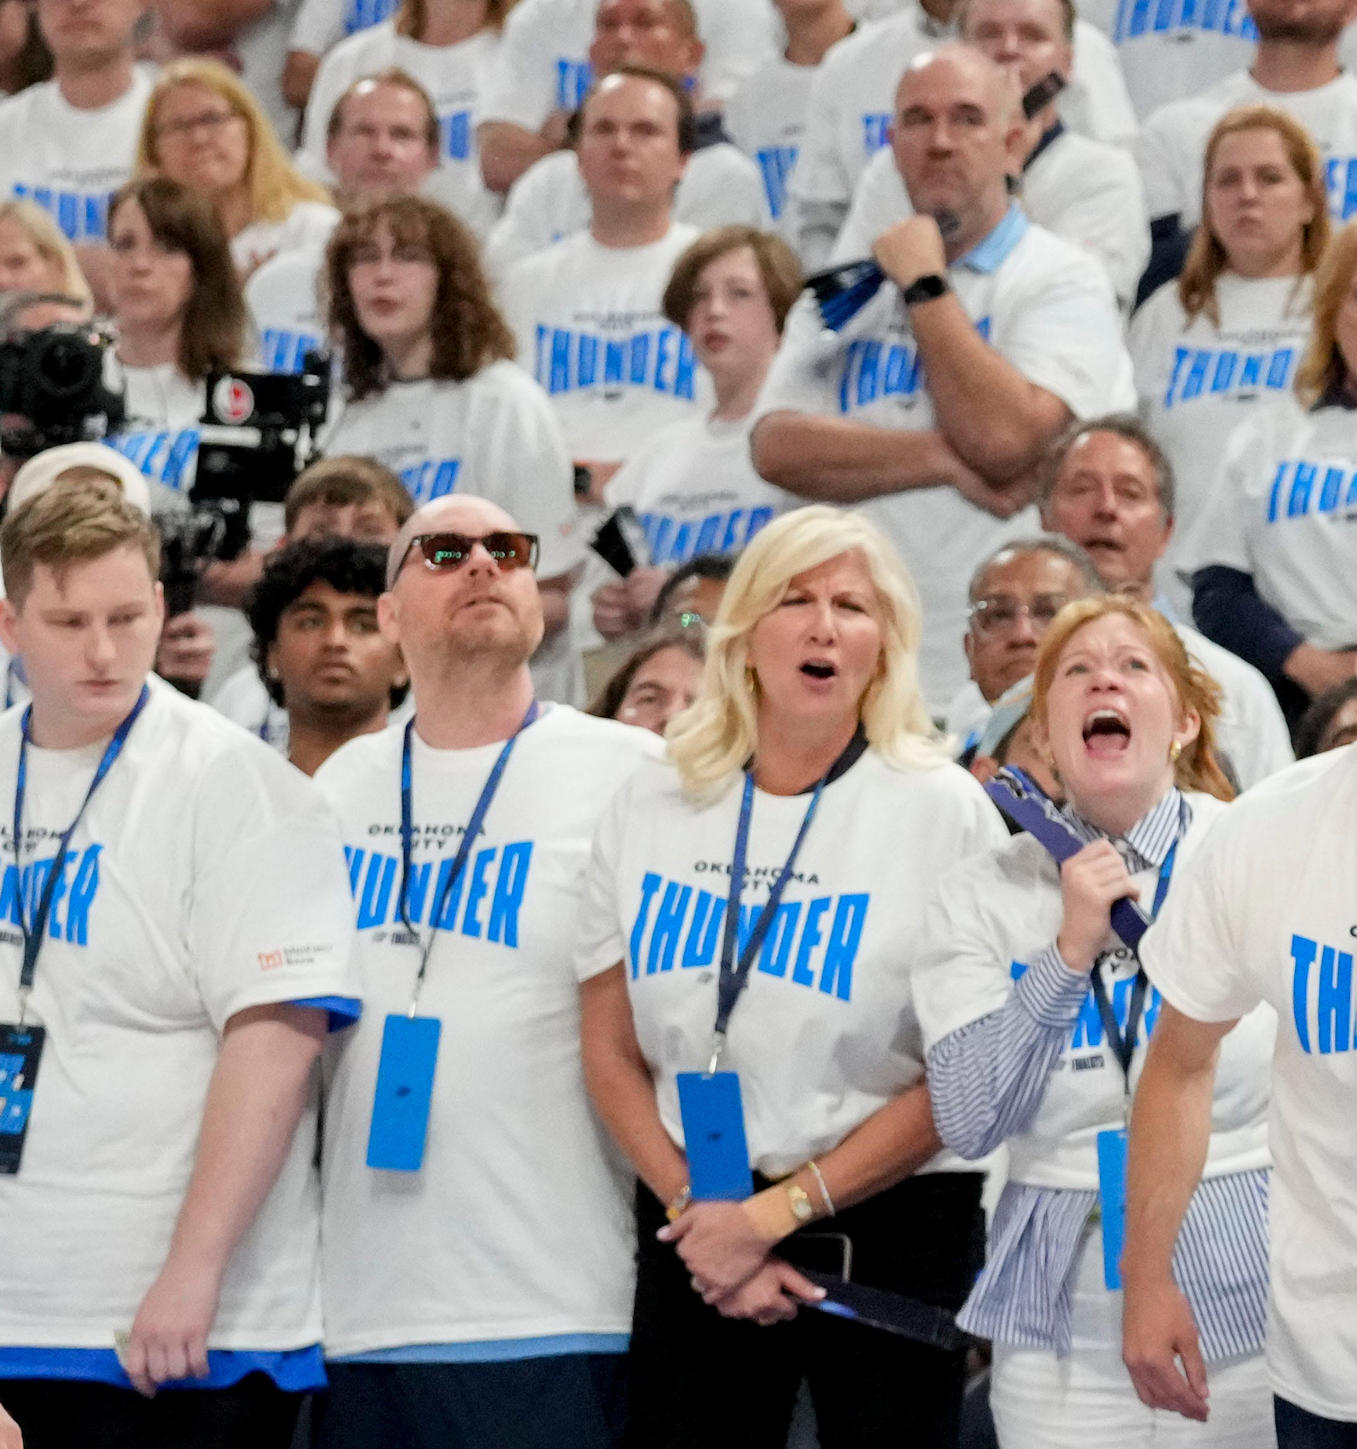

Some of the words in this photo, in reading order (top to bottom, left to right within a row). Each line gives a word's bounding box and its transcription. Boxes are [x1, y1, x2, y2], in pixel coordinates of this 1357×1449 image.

[1166, 347, 1294, 409] THUND
[368, 824, 488, 838] OKAHOA
[343, 840, 535, 949] UNDER
